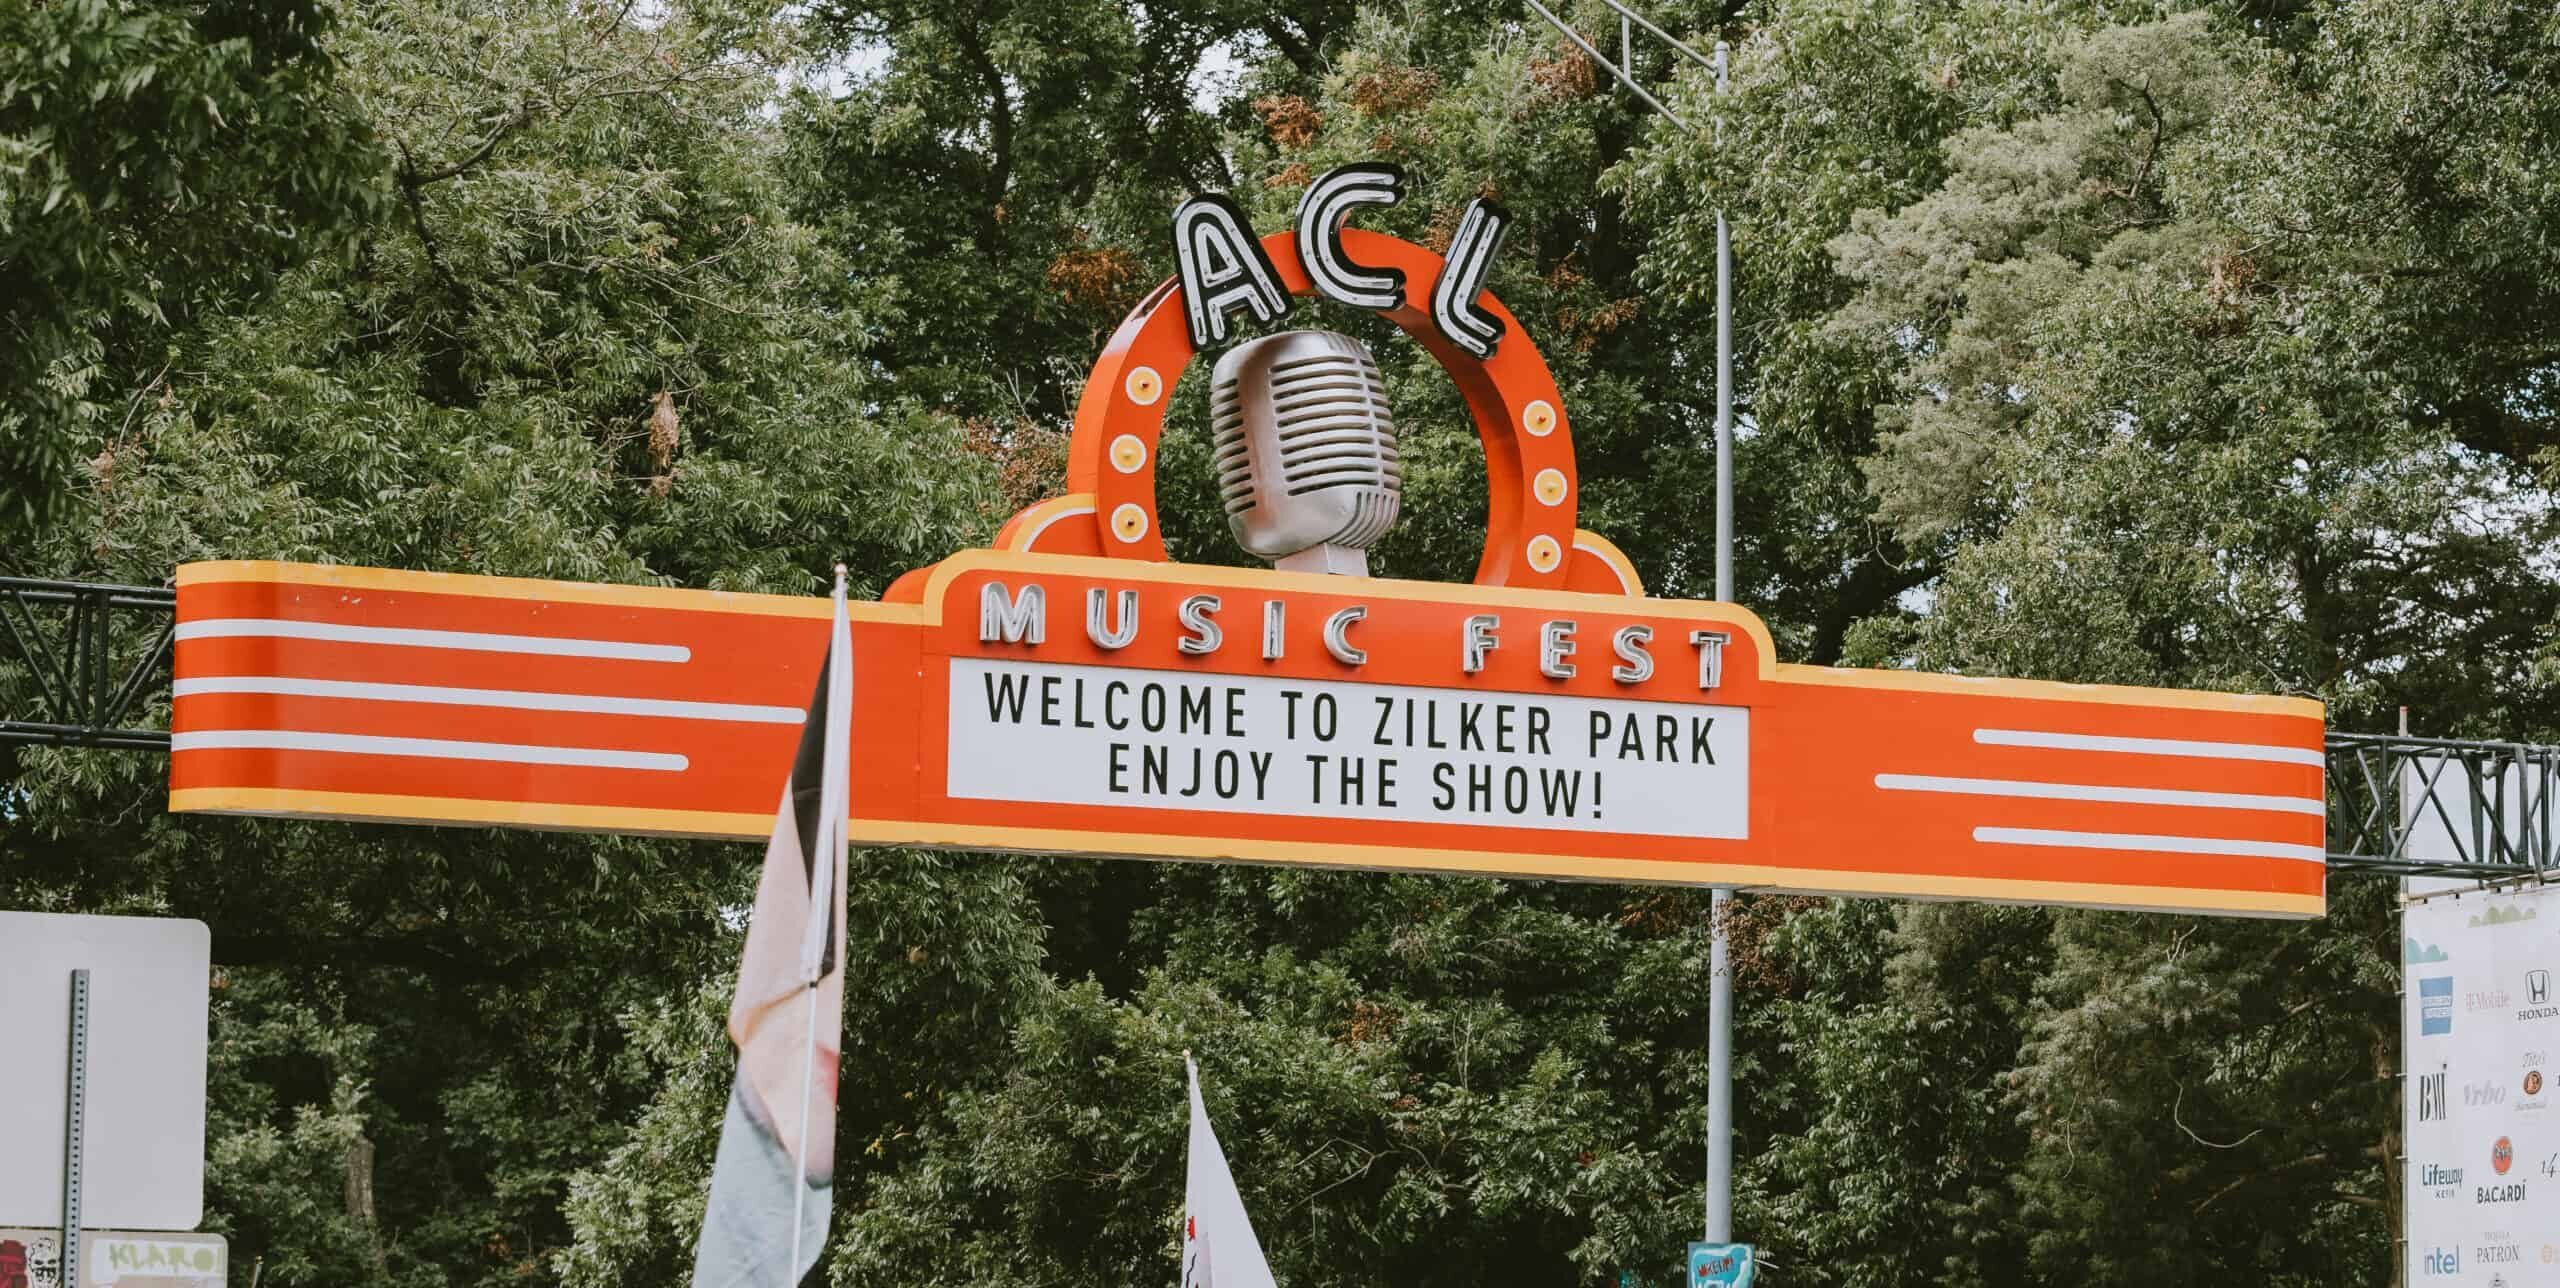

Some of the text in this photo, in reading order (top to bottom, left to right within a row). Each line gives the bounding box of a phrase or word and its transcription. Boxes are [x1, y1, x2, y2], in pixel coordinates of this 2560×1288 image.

[1173, 161, 1512, 360] ACL
[980, 582, 1731, 688] MUSIC FEST
[985, 673, 1715, 764] WELCOME TO ZILKER PARK
[1110, 744, 1601, 818] ENJOY THE SHOW!
[2518, 1008, 2559, 1021] HONDA
[2422, 1164, 2463, 1187] Lifeway
[2424, 1245, 2460, 1275] intel
